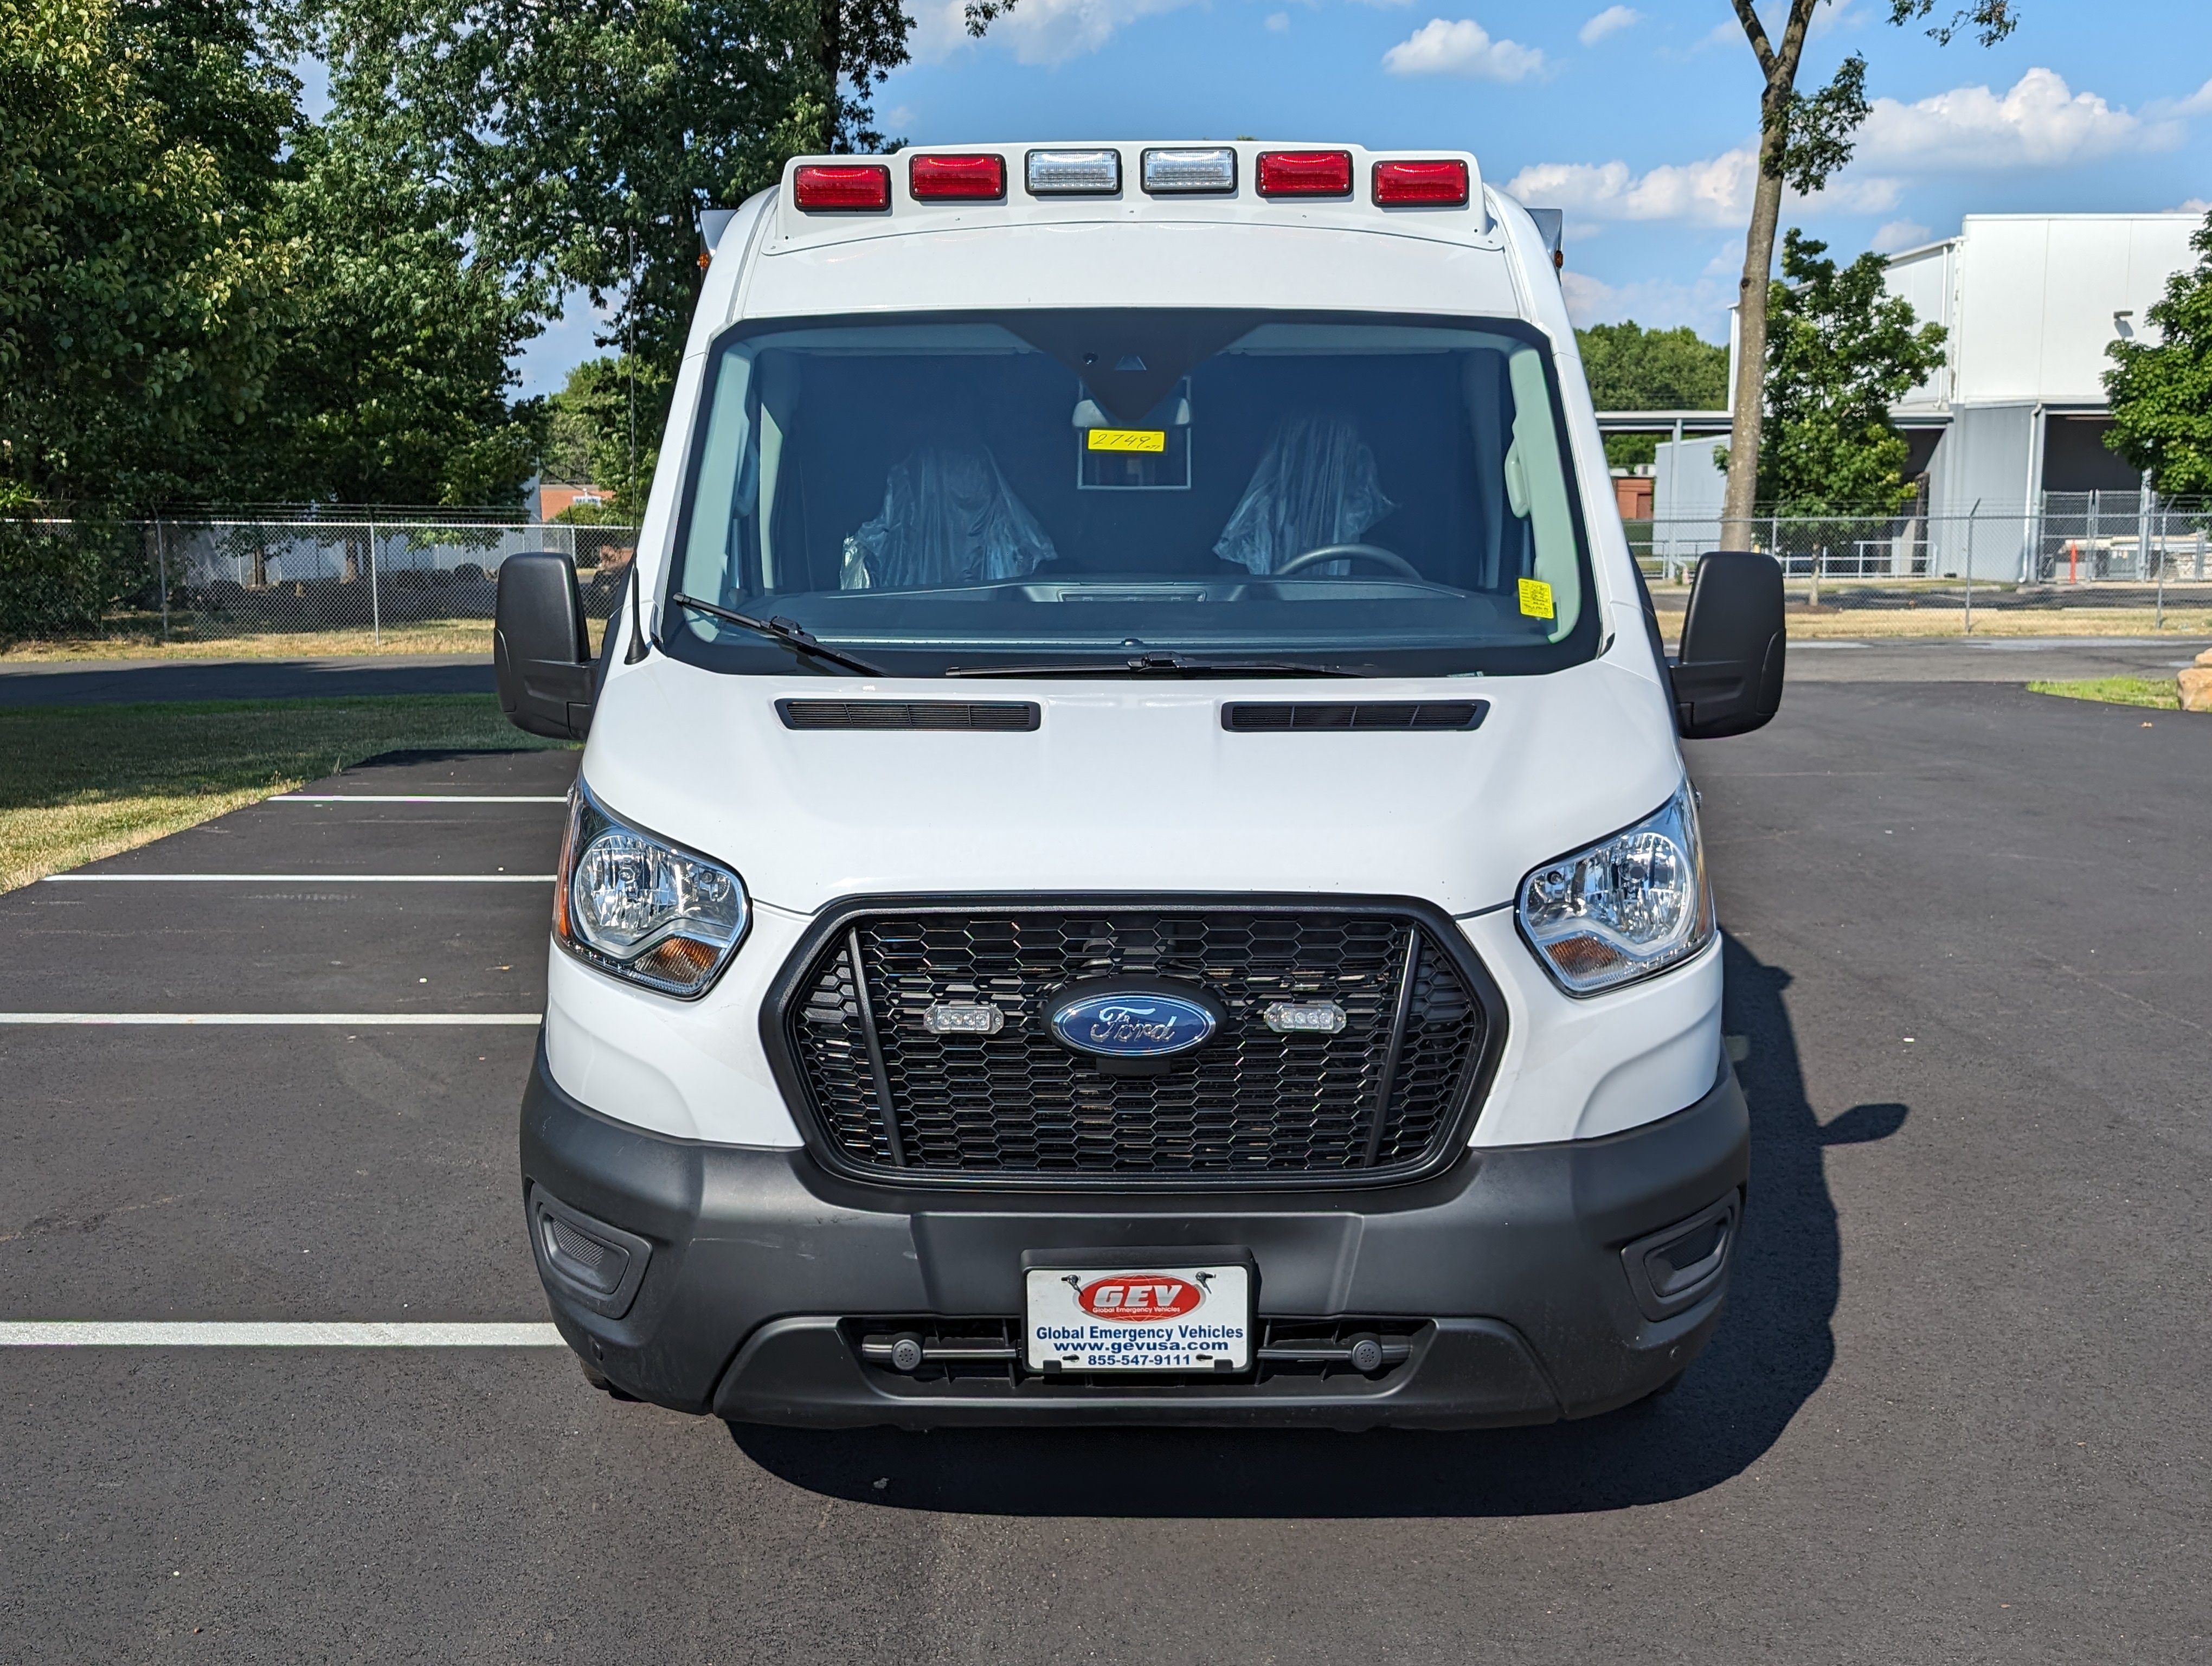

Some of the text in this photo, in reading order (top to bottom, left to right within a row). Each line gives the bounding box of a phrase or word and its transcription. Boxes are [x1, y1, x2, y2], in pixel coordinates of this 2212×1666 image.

[1092, 433, 1151, 450] 2749
[1090, 1006, 1178, 1042] Ford
[1093, 1284, 1182, 1308] GEV
[1036, 1325, 1244, 1342] Global Emergency Vehicles
[1053, 1341, 1229, 1354] www.gevusa.com
[1088, 1354, 1190, 1366] 855-547-9111
